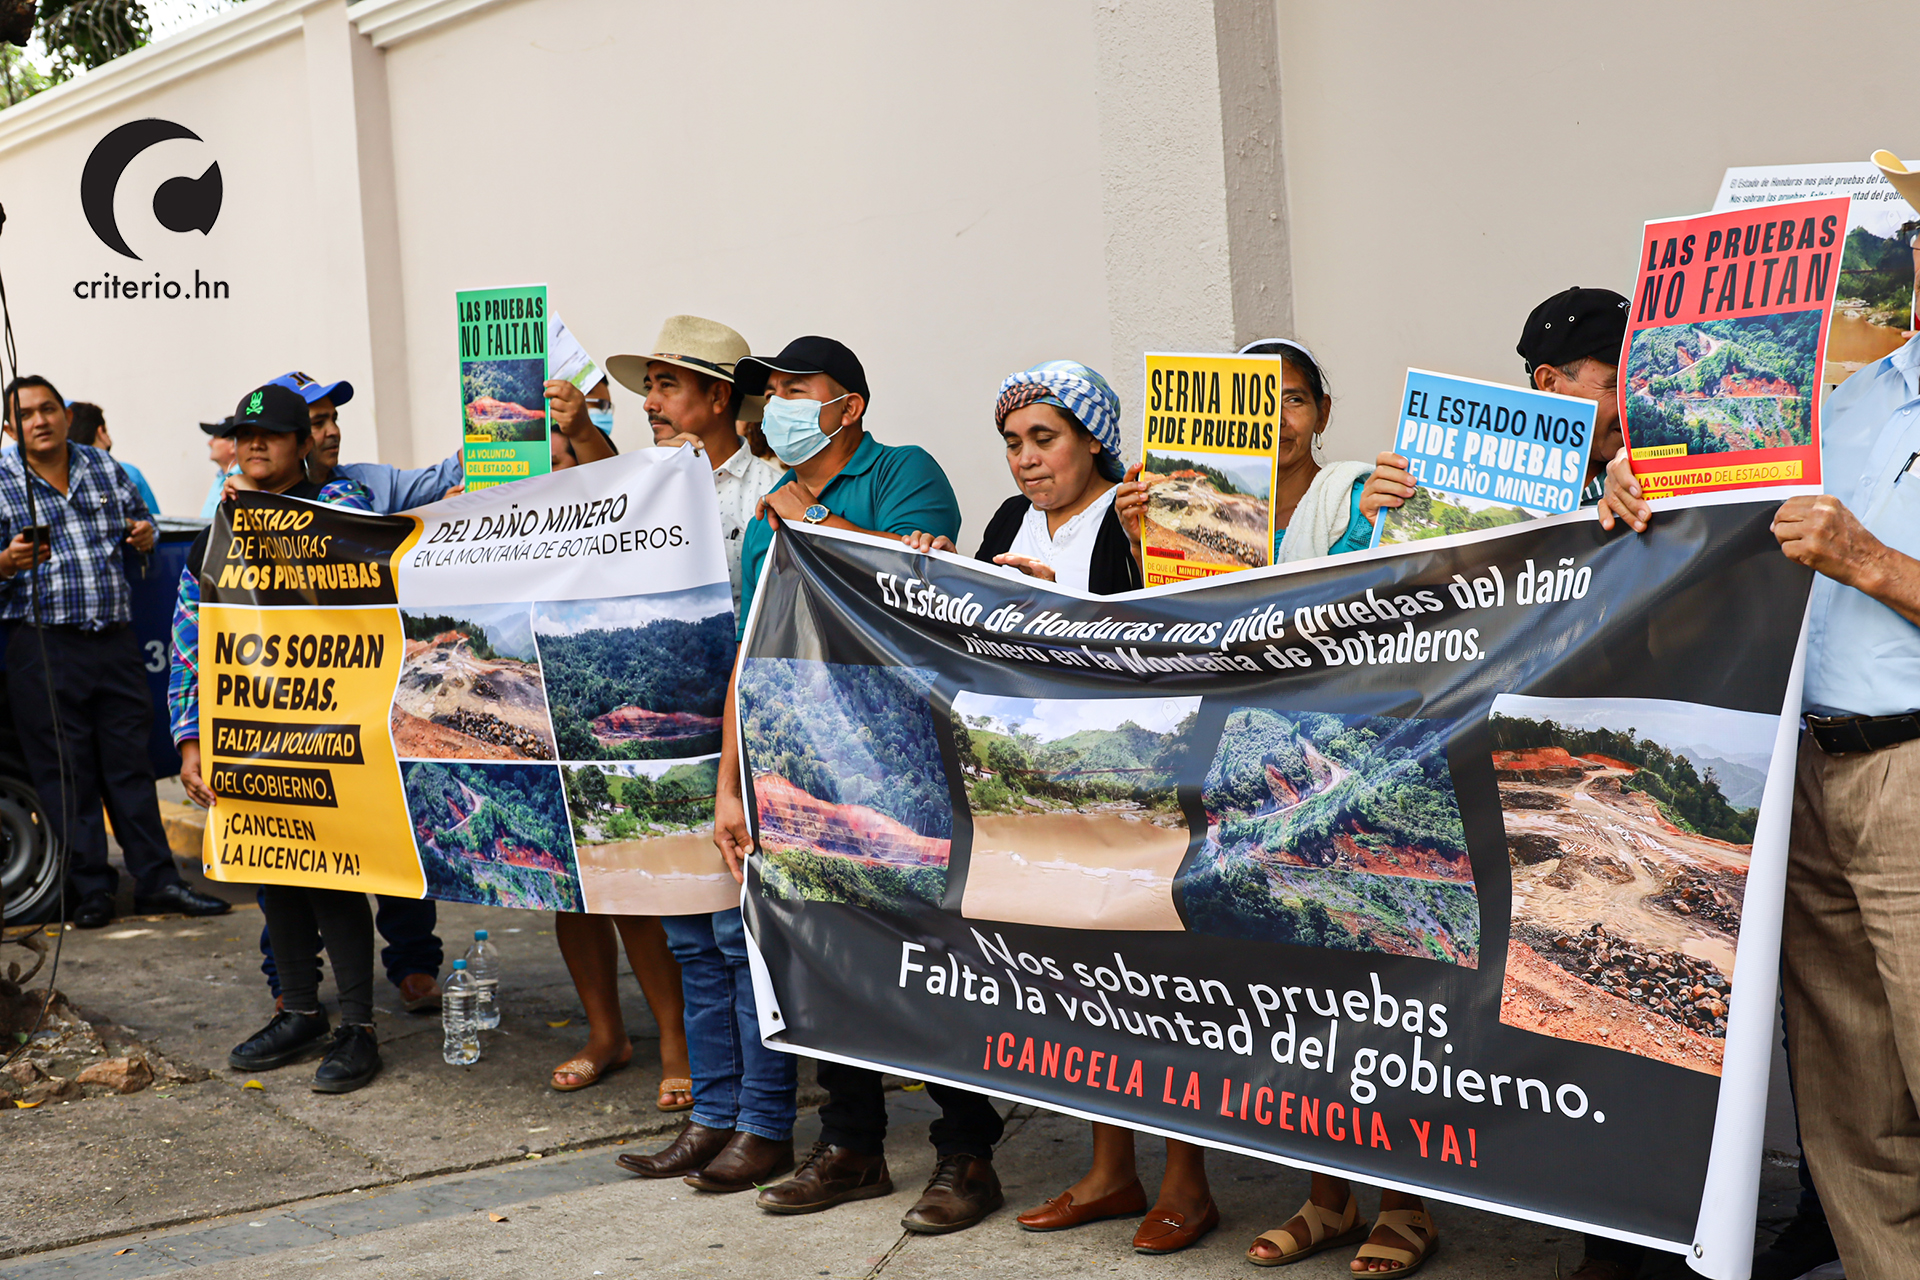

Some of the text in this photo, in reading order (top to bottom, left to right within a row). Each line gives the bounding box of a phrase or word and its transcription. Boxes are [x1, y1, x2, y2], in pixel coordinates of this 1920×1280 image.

[1804, 177, 1816, 186] nos
[1817, 175, 1834, 187] pide
[1835, 175, 1865, 187] pruebas
[1866, 174, 1879, 184] del
[1870, 190, 1884, 200] del
[1647, 214, 1837, 271] LAS PRUEBAS
[1637, 252, 1832, 323] NO FALTAN
[460, 297, 543, 323] LAS PRUEBAS
[461, 324, 480, 357] NO
[487, 321, 544, 356] FALTAN
[1151, 368, 1276, 417] SERNA NOS
[1148, 415, 1273, 450] PIDE PRUEBAS
[1407, 390, 1586, 448] EL ESTADO NOS
[467, 448, 516, 459] LA VOLUNTAD
[1400, 419, 1580, 484] PIDE PRUEBAS
[469, 464, 481, 473] DEL
[483, 464, 514, 475] ESTADO,
[1402, 456, 1574, 512] EL DAÑO MINERO
[1639, 462, 1799, 488] LA VOLUNTAD DEL ESTADO, SÍ.
[427, 493, 628, 545] DEL DAÑO MINERO
[227, 535, 332, 559] DE HONDURAS
[413, 525, 690, 568] EN LA MONTAÑA DE BOTADEROS.
[217, 561, 382, 591] NOS PIDE PRUEBAS
[1148, 562, 1155, 571] DE
[1156, 563, 1168, 572] QUE
[1169, 565, 1176, 573] LA
[1149, 574, 1164, 584] ESTÁ
[875, 557, 1592, 651] El Estado de Honduras nos pide pruebas del daño
[145, 640, 171, 673] 3
[215, 632, 384, 669] NOS SOBRAN
[958, 621, 1486, 675] minero en la Montaña de Botaderos.
[216, 673, 338, 712] PRUEBAS.
[217, 727, 355, 757] FALTA LA VOLUNTAD
[214, 771, 332, 800] DEL GOBIERNO.
[223, 813, 316, 841] ¡CANCELEN
[220, 843, 361, 876] LA LICENCIA YA!
[970, 927, 1448, 1039] Nos sobran pruebas
[898, 941, 1606, 1124] Falta la voluntad del gobierno.
[983, 1031, 1478, 1168] ¡CANCELA LA LICENCIA YA!
